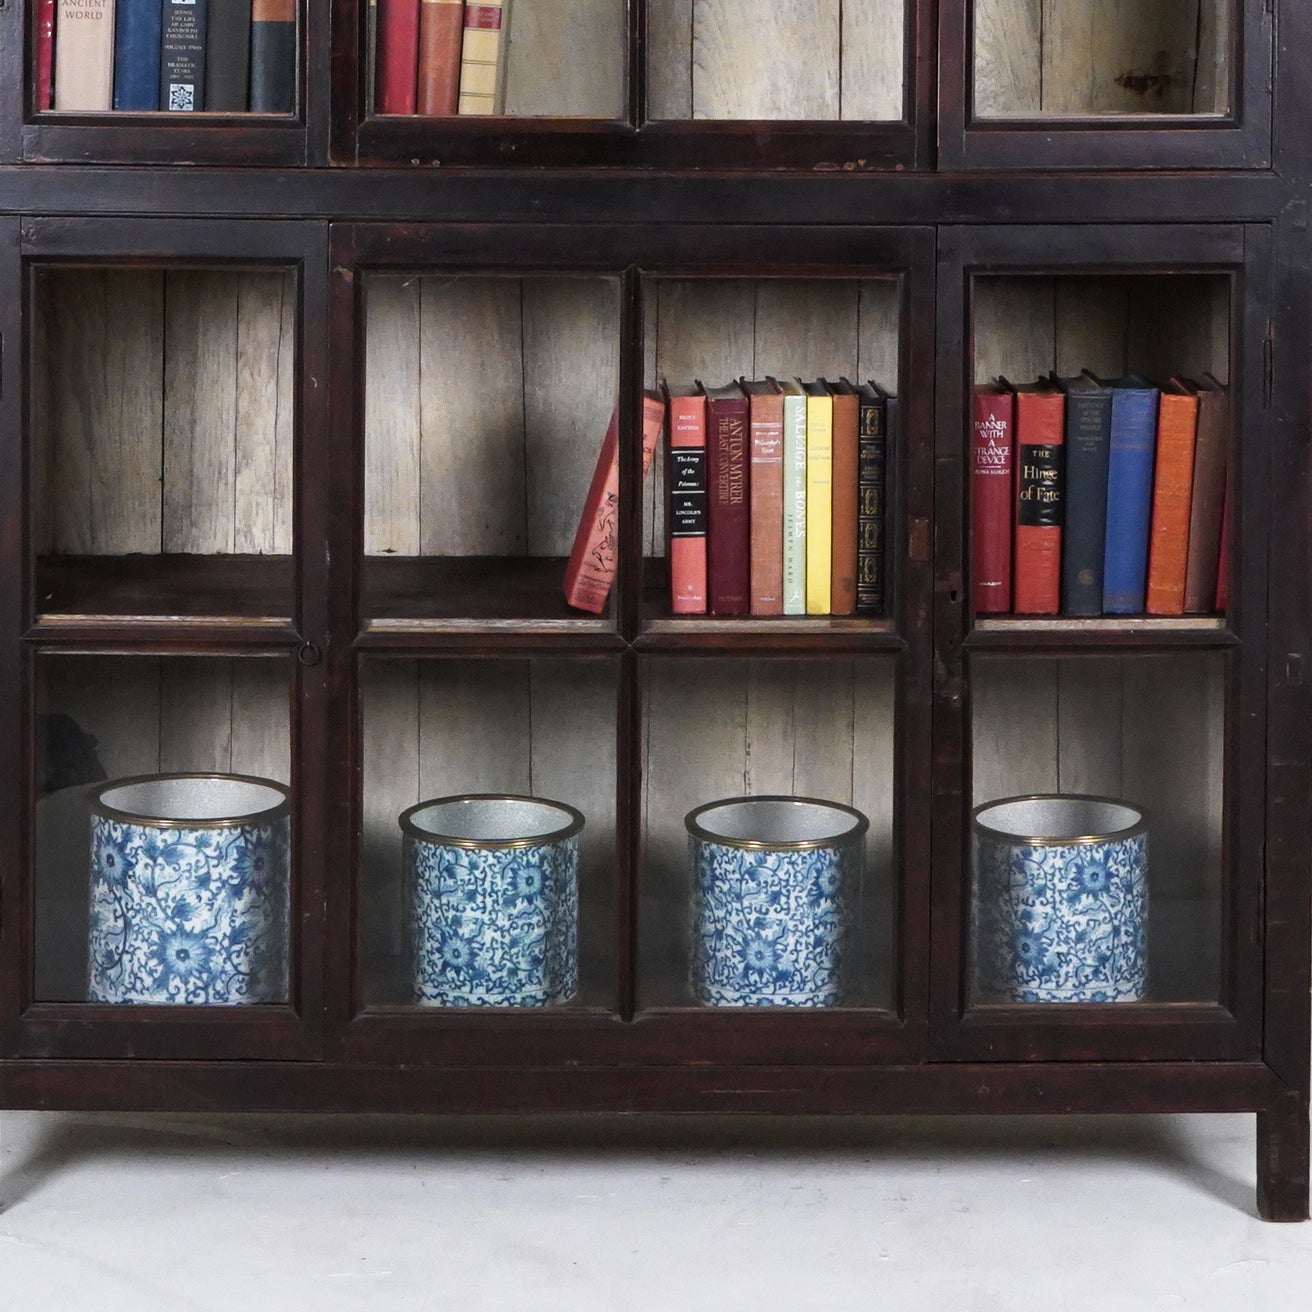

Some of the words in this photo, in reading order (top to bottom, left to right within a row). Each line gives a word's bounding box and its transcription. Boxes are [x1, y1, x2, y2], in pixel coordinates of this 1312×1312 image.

[64, 10, 103, 20] WORLD
[989, 413, 996, 421] A
[974, 420, 1008, 429] BANNER
[795, 406, 806, 471] SALVAGE
[979, 429, 1004, 438] WITH
[729, 418, 743, 461] ANTON
[988, 439, 996, 447] A
[1032, 450, 1050, 458] THE
[977, 455, 1006, 465] DEVICE
[1023, 465, 1058, 480] Hinge
[729, 464, 743, 505] MYRER
[1020, 484, 1035, 501] of
[1036, 487, 1061, 501] Fate
[794, 491, 806, 538] BONES
